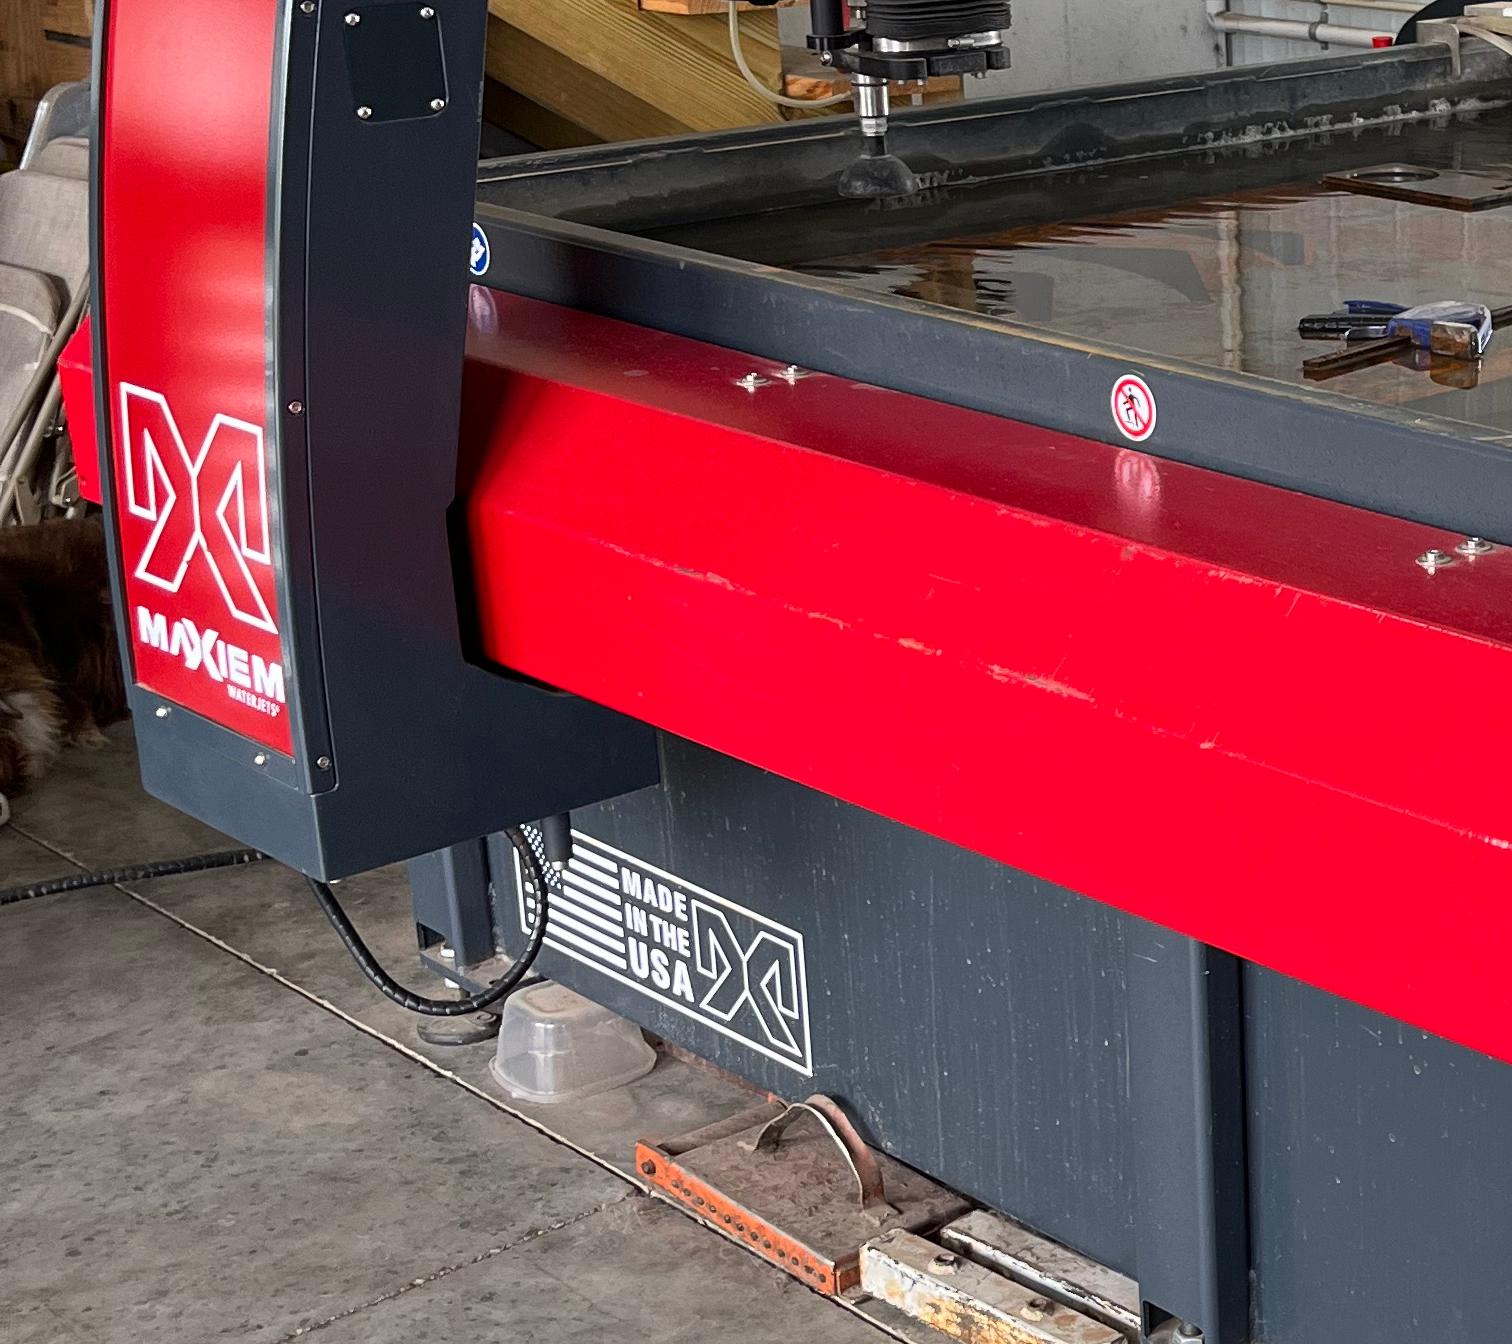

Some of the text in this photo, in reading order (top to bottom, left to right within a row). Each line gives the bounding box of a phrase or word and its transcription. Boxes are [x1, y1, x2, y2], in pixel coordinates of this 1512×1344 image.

[137, 605, 286, 704] MAXIEM
[621, 866, 689, 922] MADE
[624, 902, 691, 958] IN THE
[627, 936, 695, 1003] USA
